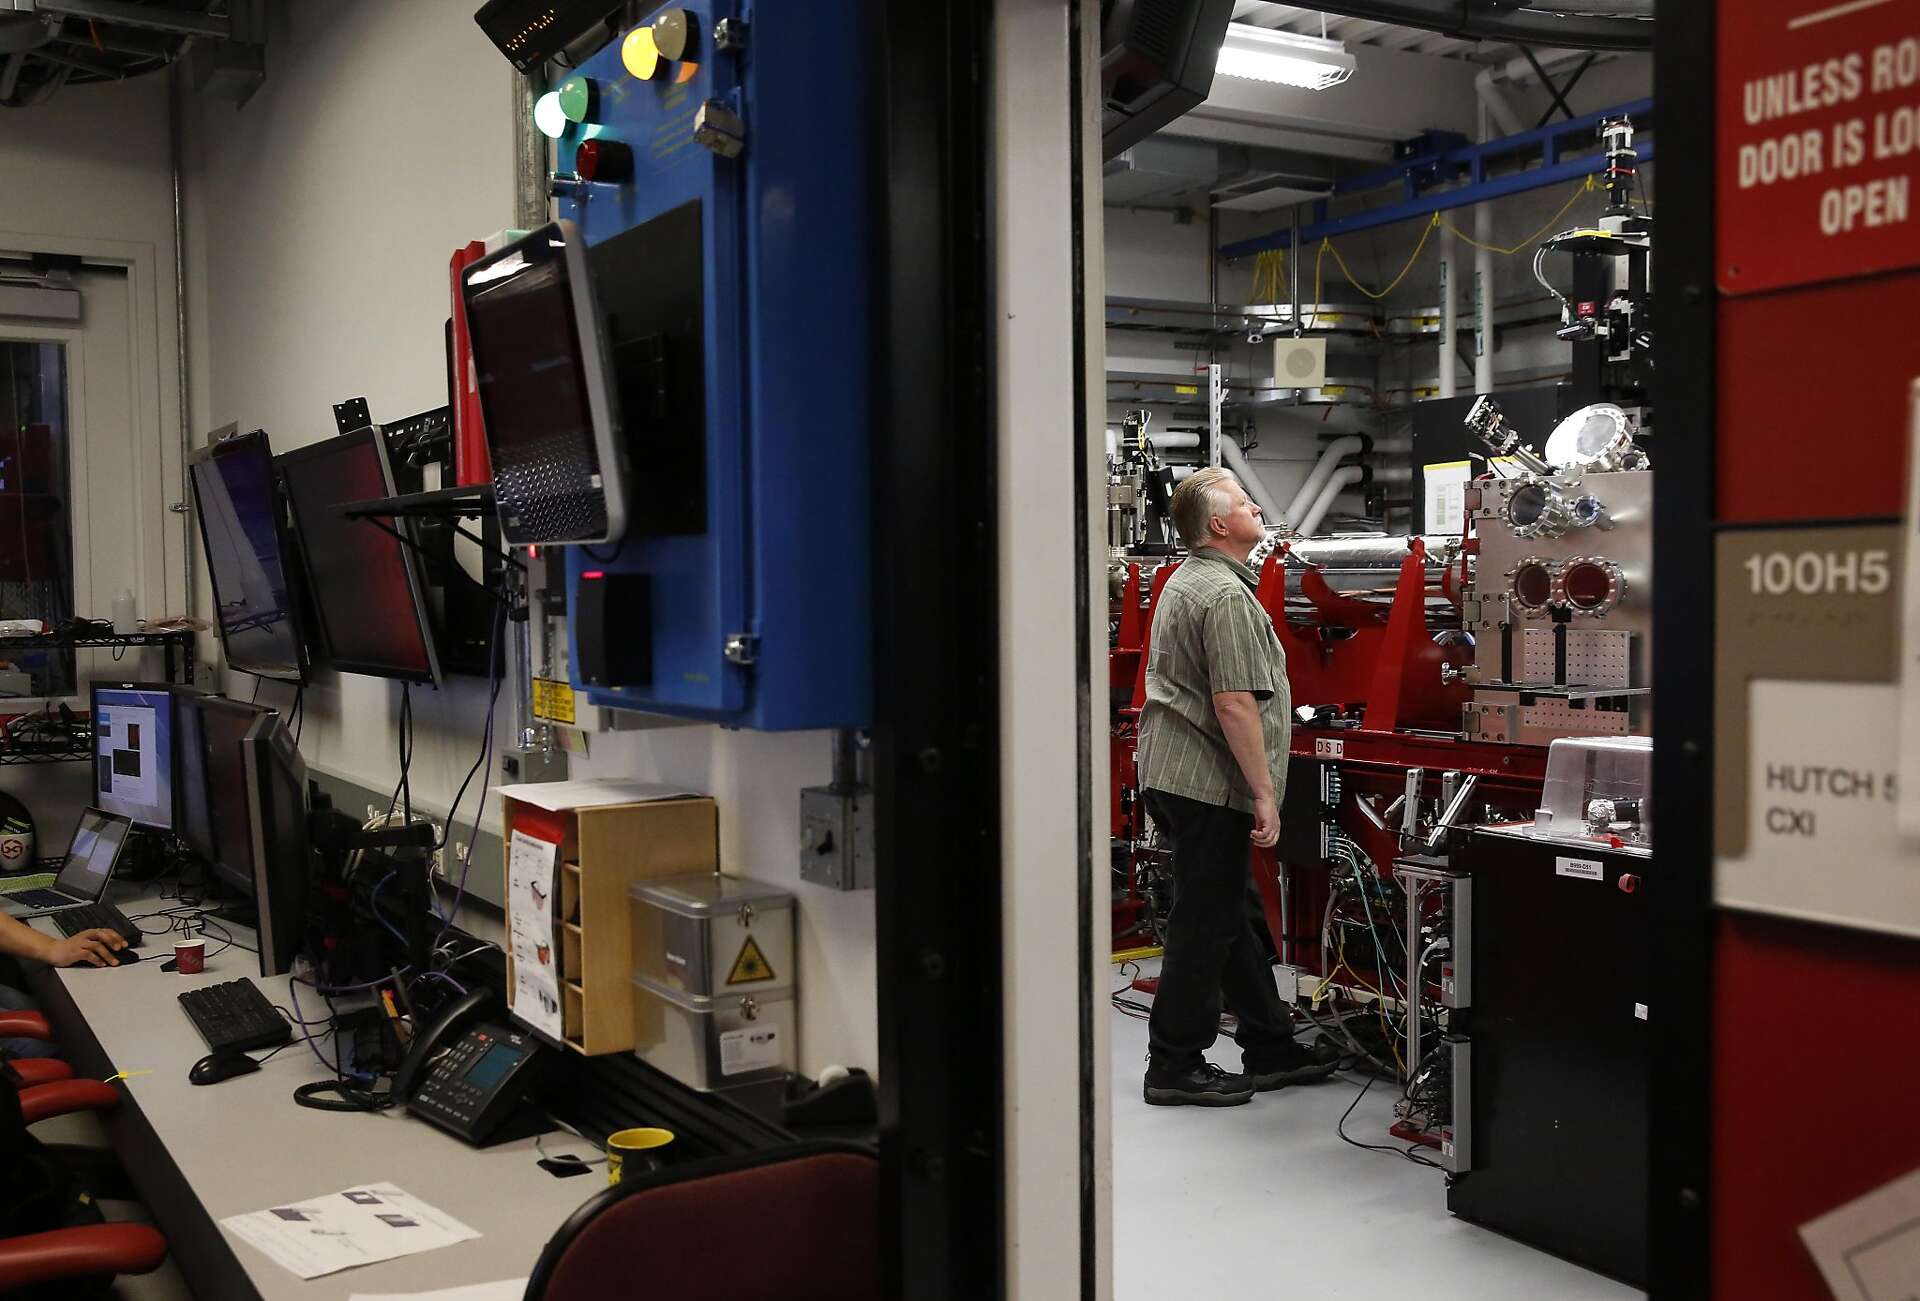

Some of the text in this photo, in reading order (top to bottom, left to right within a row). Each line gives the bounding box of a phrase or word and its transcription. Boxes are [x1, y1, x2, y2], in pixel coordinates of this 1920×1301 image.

[1744, 37, 1920, 125] UNLESS RO
[1739, 105, 1920, 189] DOOR IS LO
[1820, 175, 1909, 235] OPEN
[1744, 550, 1889, 594] 100H5
[1766, 764, 1875, 800] HUTCH
[1766, 805, 1816, 837] CXI
